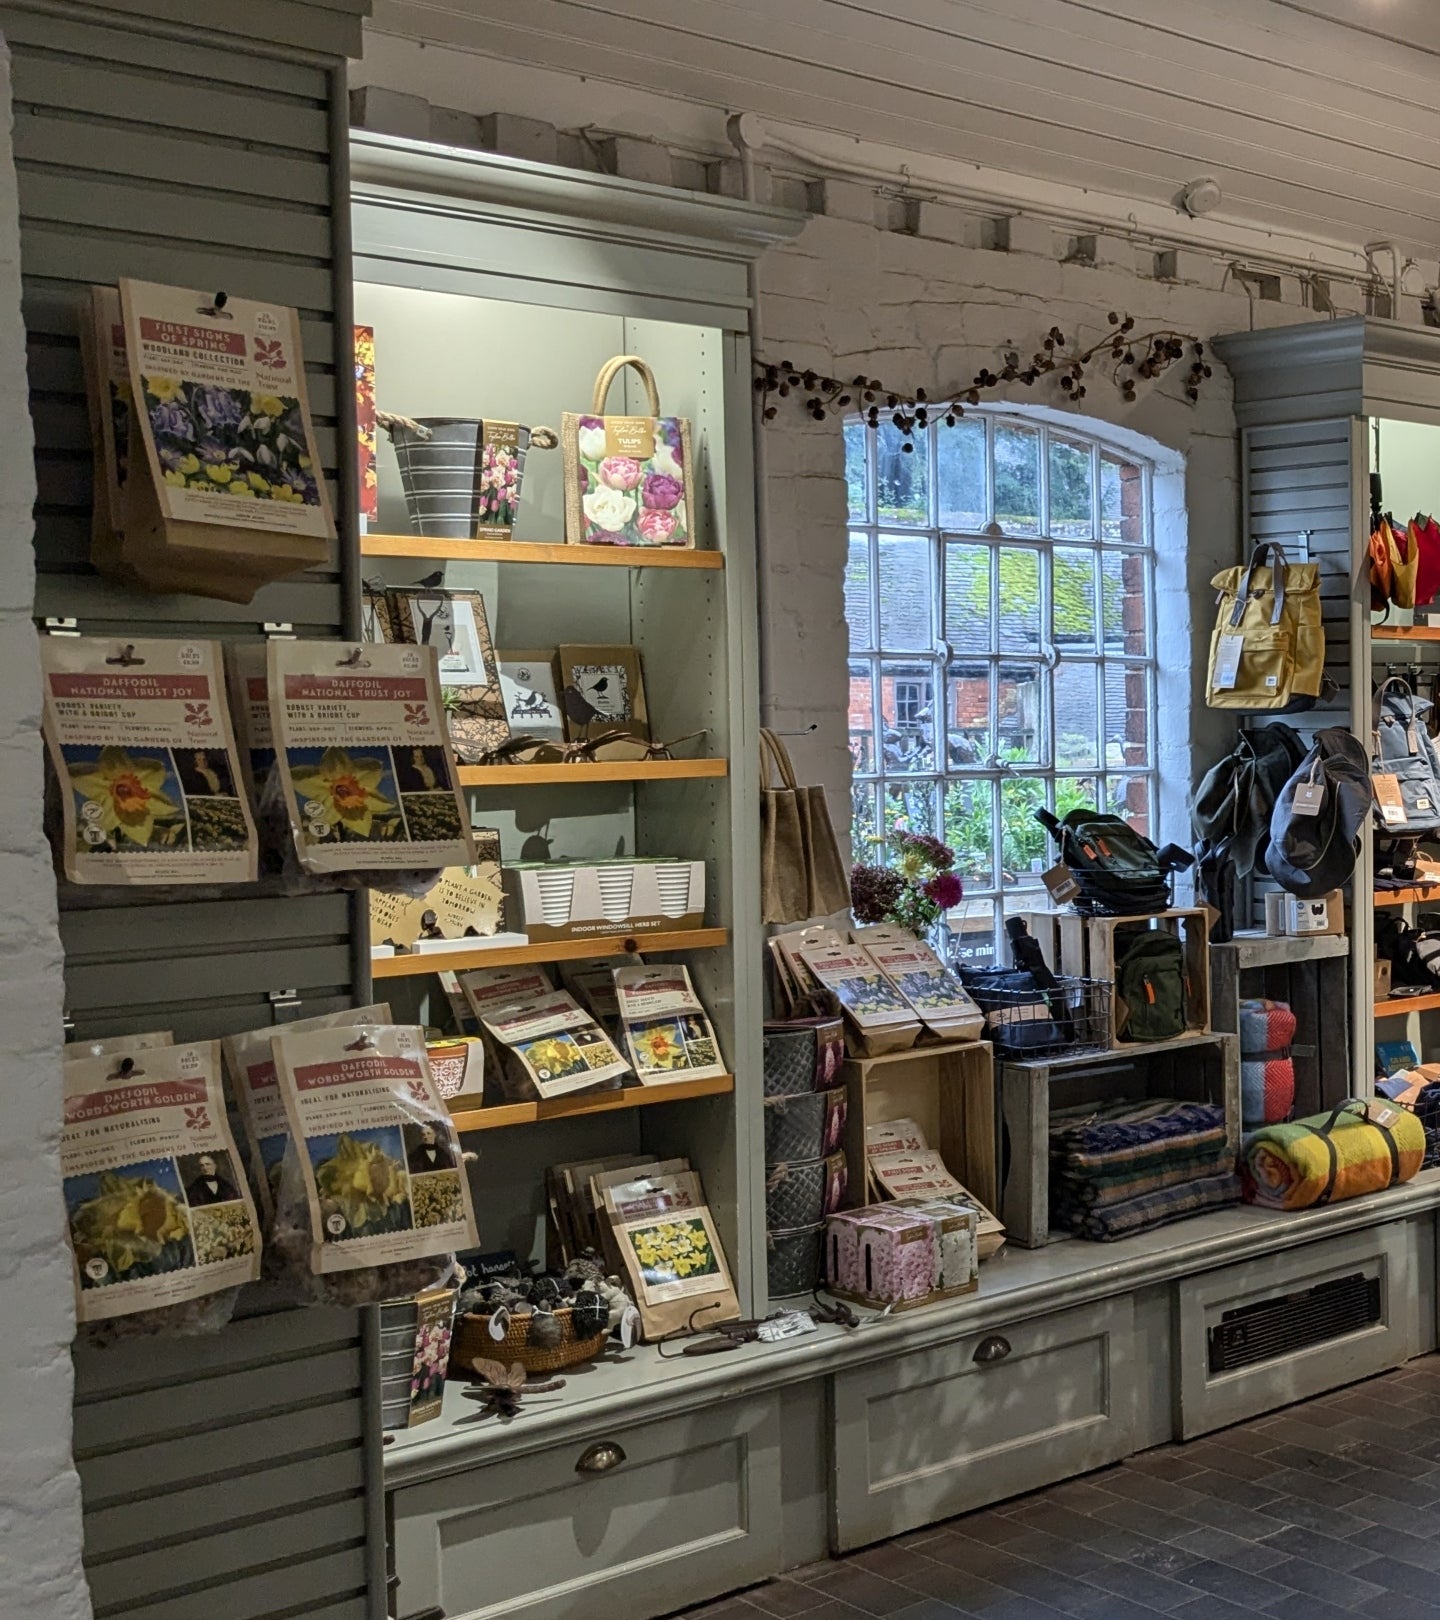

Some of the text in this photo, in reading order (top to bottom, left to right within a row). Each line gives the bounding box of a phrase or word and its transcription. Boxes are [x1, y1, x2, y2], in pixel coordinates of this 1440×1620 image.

[154, 322, 231, 343] FIRST SIGNS
[161, 332, 227, 351] OF SPRING
[193, 352, 245, 367] COLLECTION
[103, 677, 160, 688] DAFFODIL
[331, 679, 382, 688] DAFFODIL
[134, 687, 168, 697] TRUST
[359, 689, 389, 698] TRUST
[444, 879, 462, 891] PLANT
[469, 888, 492, 901] GARDEN
[442, 897, 476, 915] TOMORROW
[446, 889, 454, 897] TO
[455, 892, 478, 906] BELIEVE
[479, 901, 486, 909] IN
[377, 917, 393, 928] NEAR
[384, 910, 399, 922] ONES
[596, 923, 634, 931] WINDOWSILL
[341, 1059, 387, 1071] DAFFODIL
[104, 1086, 159, 1104] DAFFODIL
[301, 1086, 390, 1105] IDEAL FOR NATURALISING
[85, 1129, 100, 1138] FOR
[104, 1116, 161, 1133] NATURALISING
